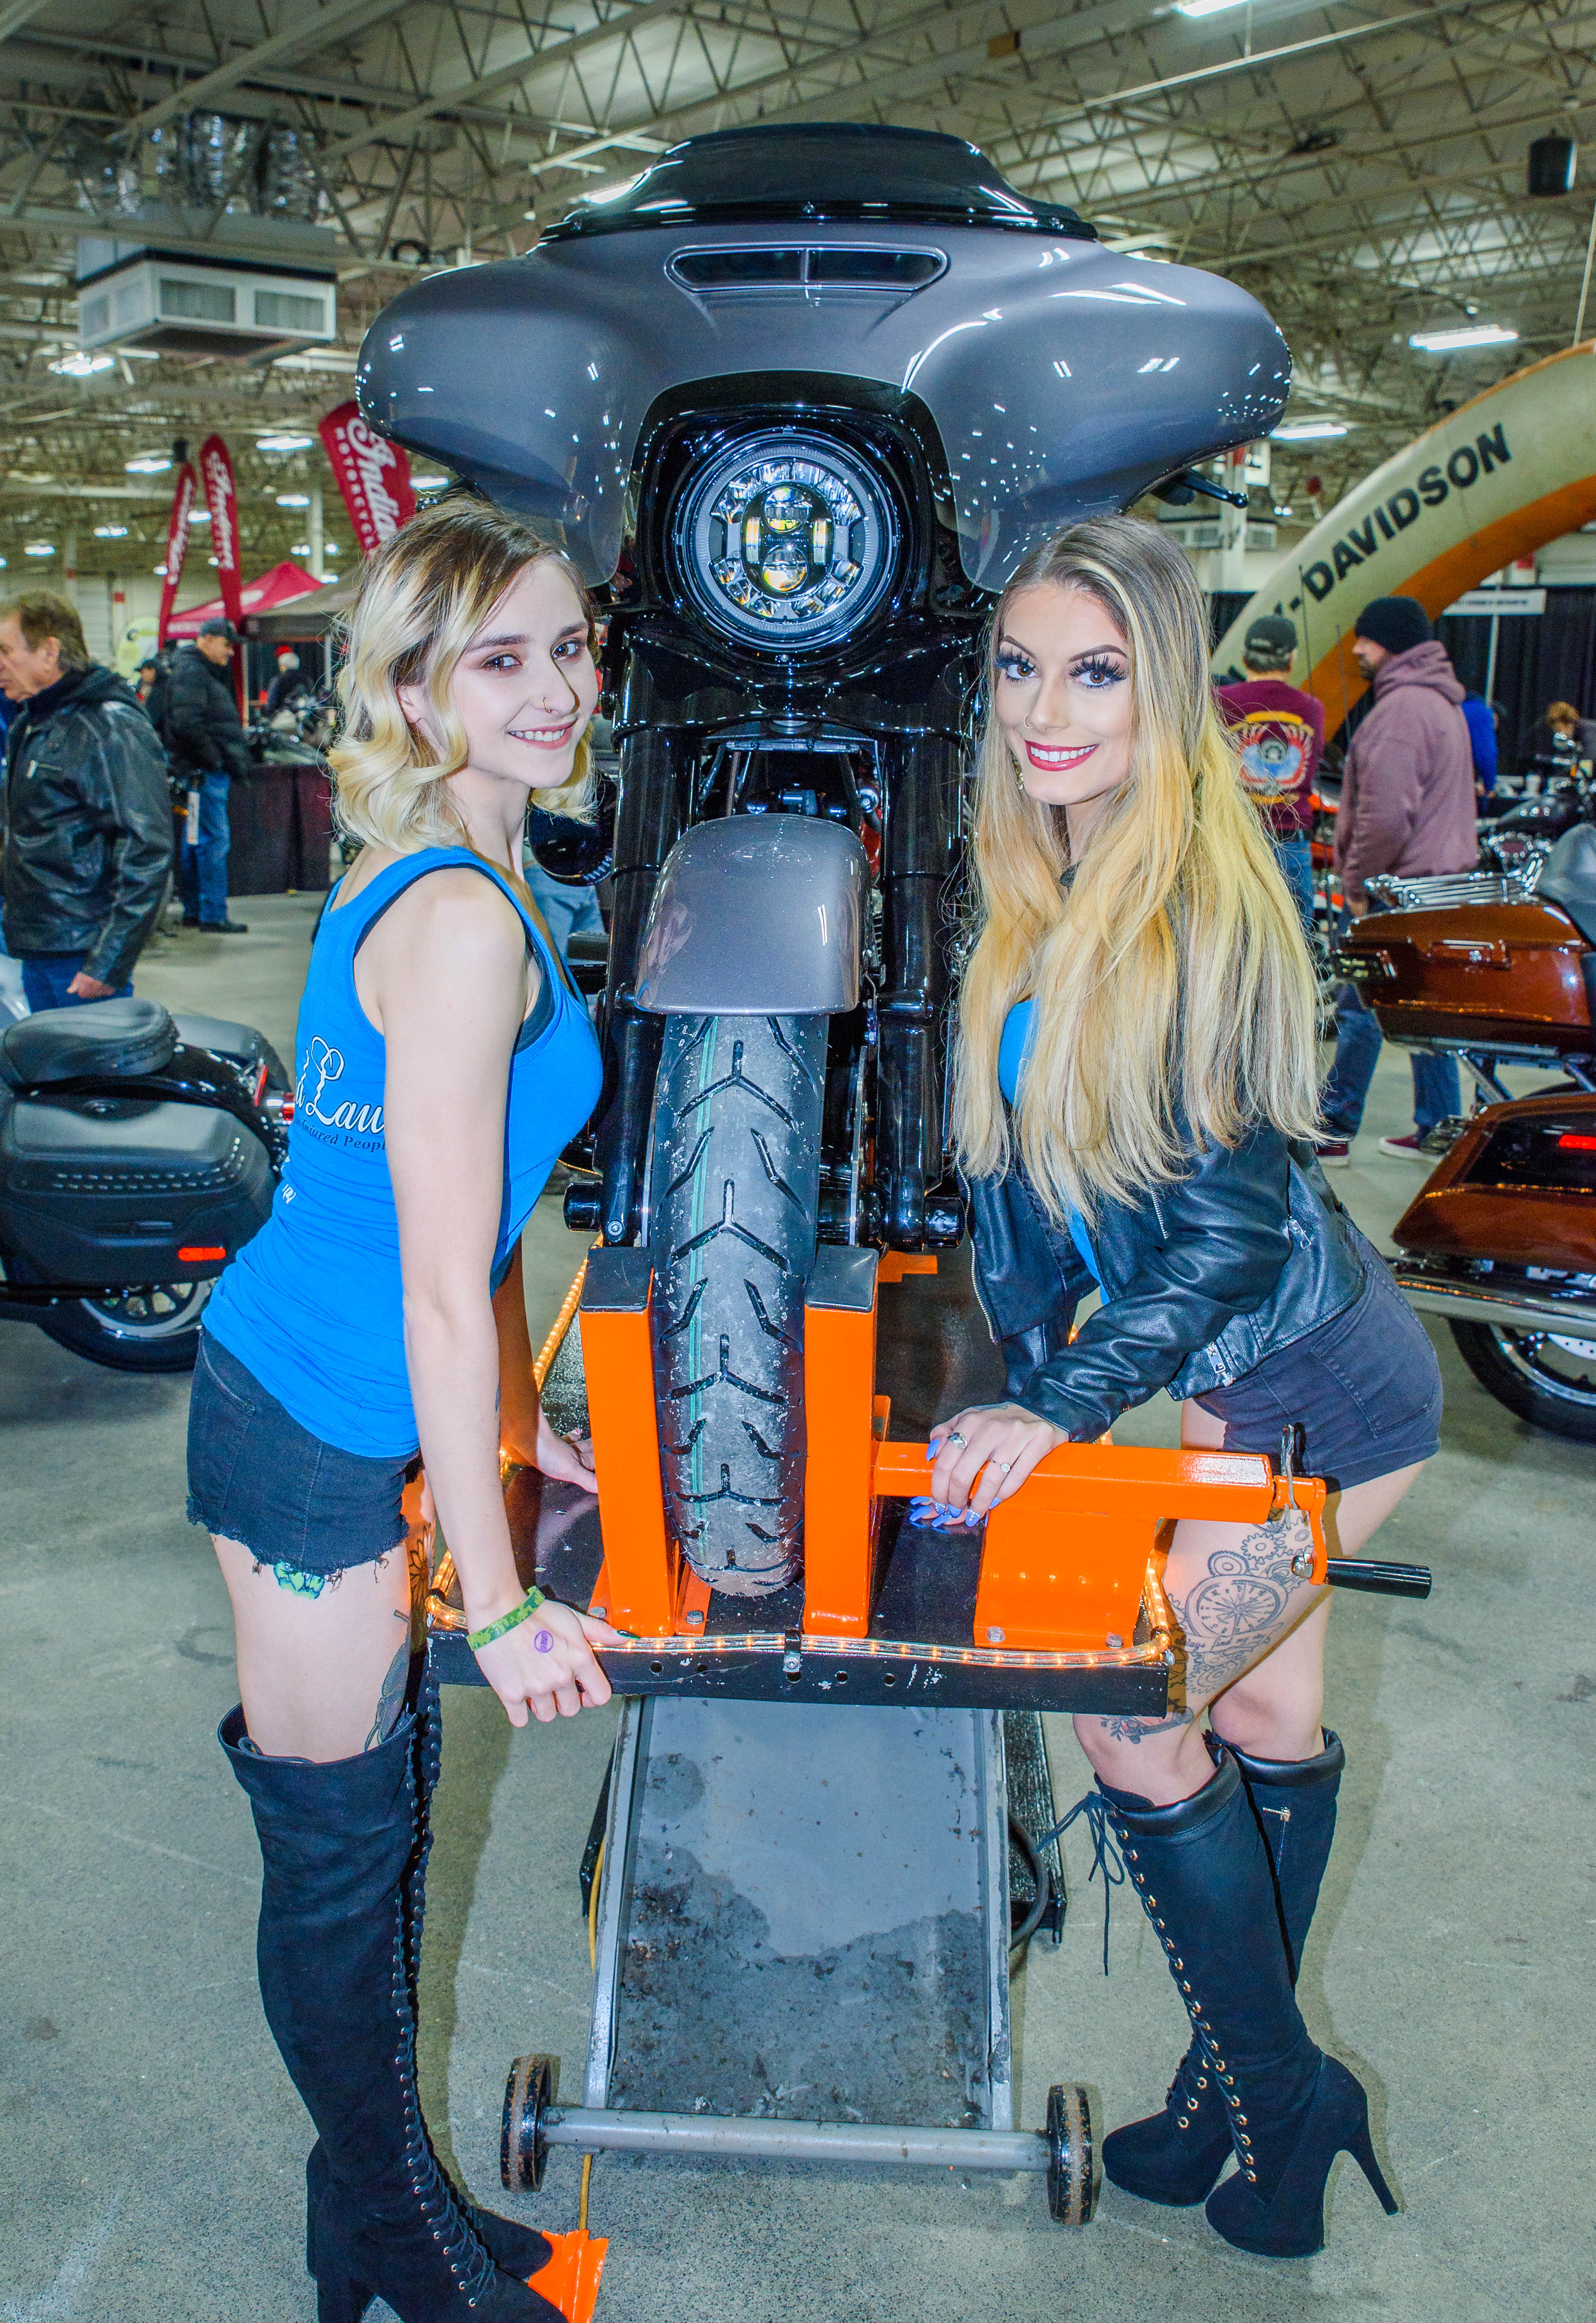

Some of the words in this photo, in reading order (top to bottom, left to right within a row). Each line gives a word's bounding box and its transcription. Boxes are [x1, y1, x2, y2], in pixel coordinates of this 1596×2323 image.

[335, 427, 375, 546] MOTORCYCL
[1273, 422, 1512, 614] -DAVIDSON
[302, 1119, 339, 1145] Injured
[343, 1135, 386, 1154] Peopl
